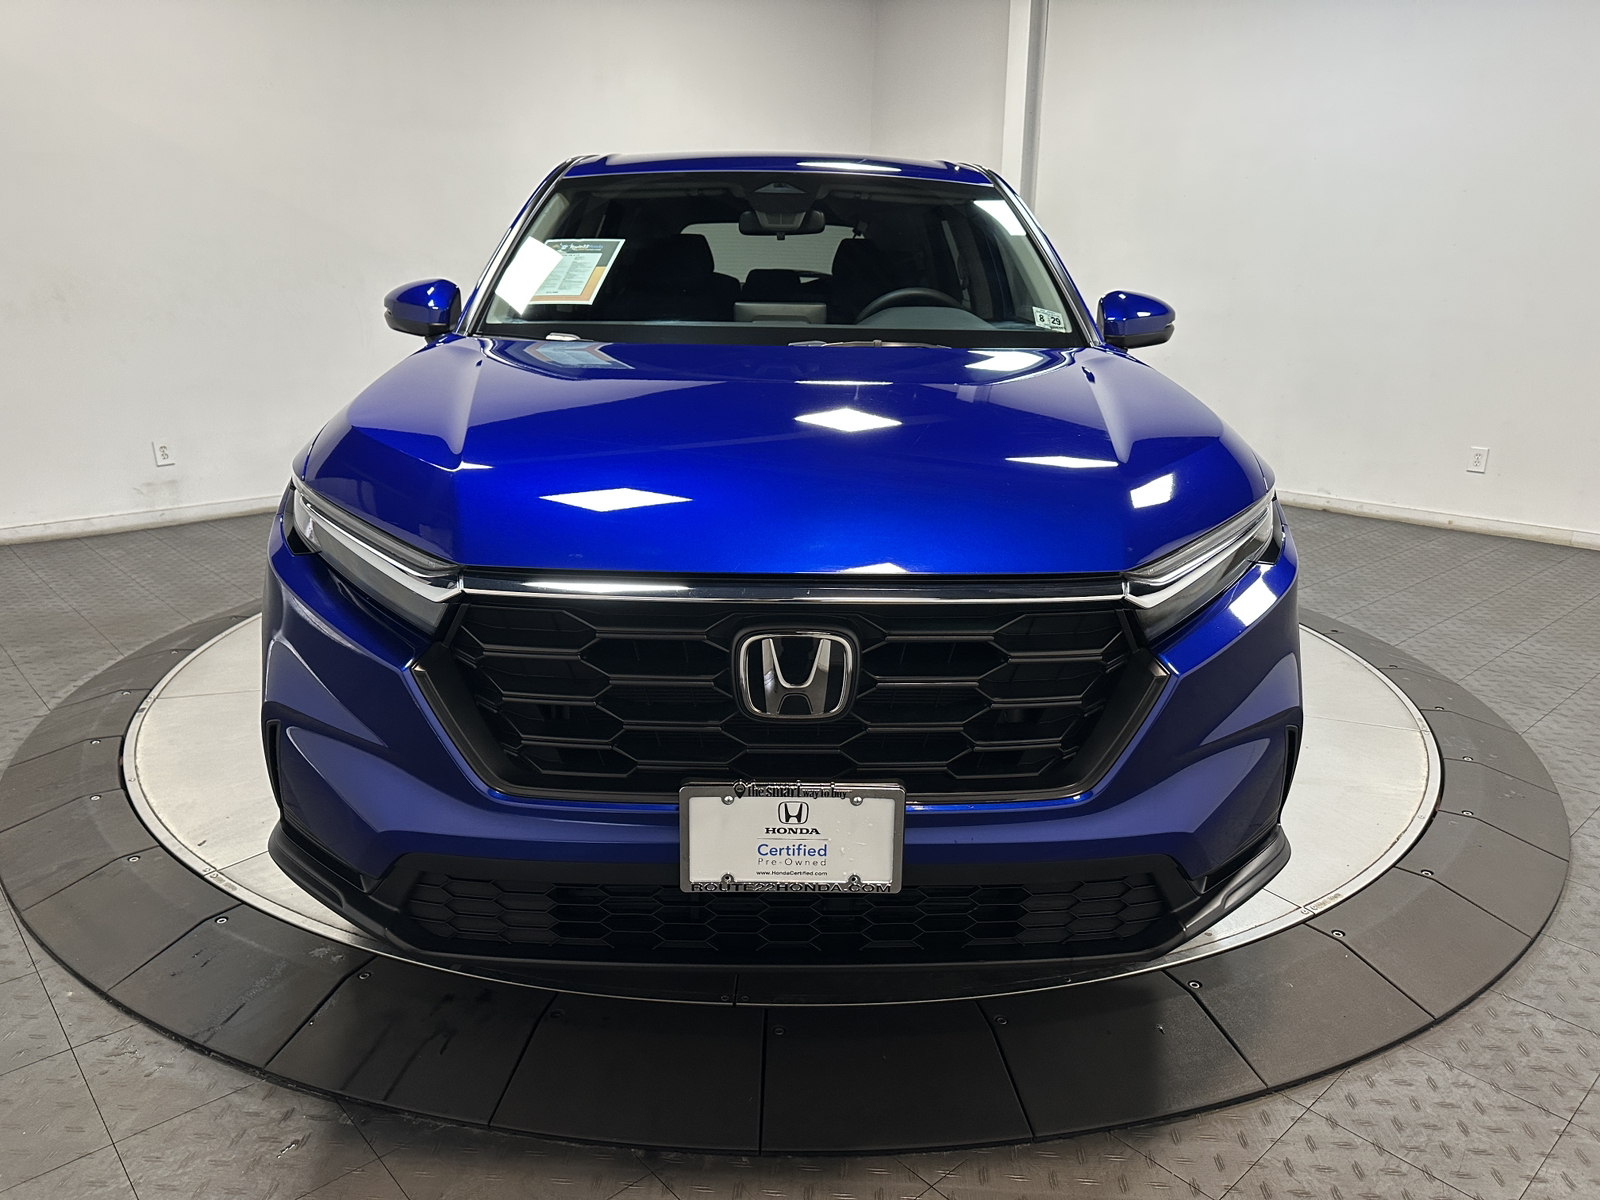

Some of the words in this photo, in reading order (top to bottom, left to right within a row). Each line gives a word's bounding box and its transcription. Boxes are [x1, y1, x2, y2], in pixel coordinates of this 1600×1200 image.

[1039, 314, 1045, 322] 8
[1050, 317, 1061, 325] 29
[747, 782, 764, 798] the
[766, 780, 802, 798] smart
[802, 788, 820, 800] way
[821, 786, 830, 798] to
[831, 781, 848, 800] buy
[764, 827, 821, 835] HONDA
[757, 843, 828, 857] Certified
[757, 858, 827, 867] Pre-Owned
[690, 882, 892, 893] ROUTE22HONDA.COM
